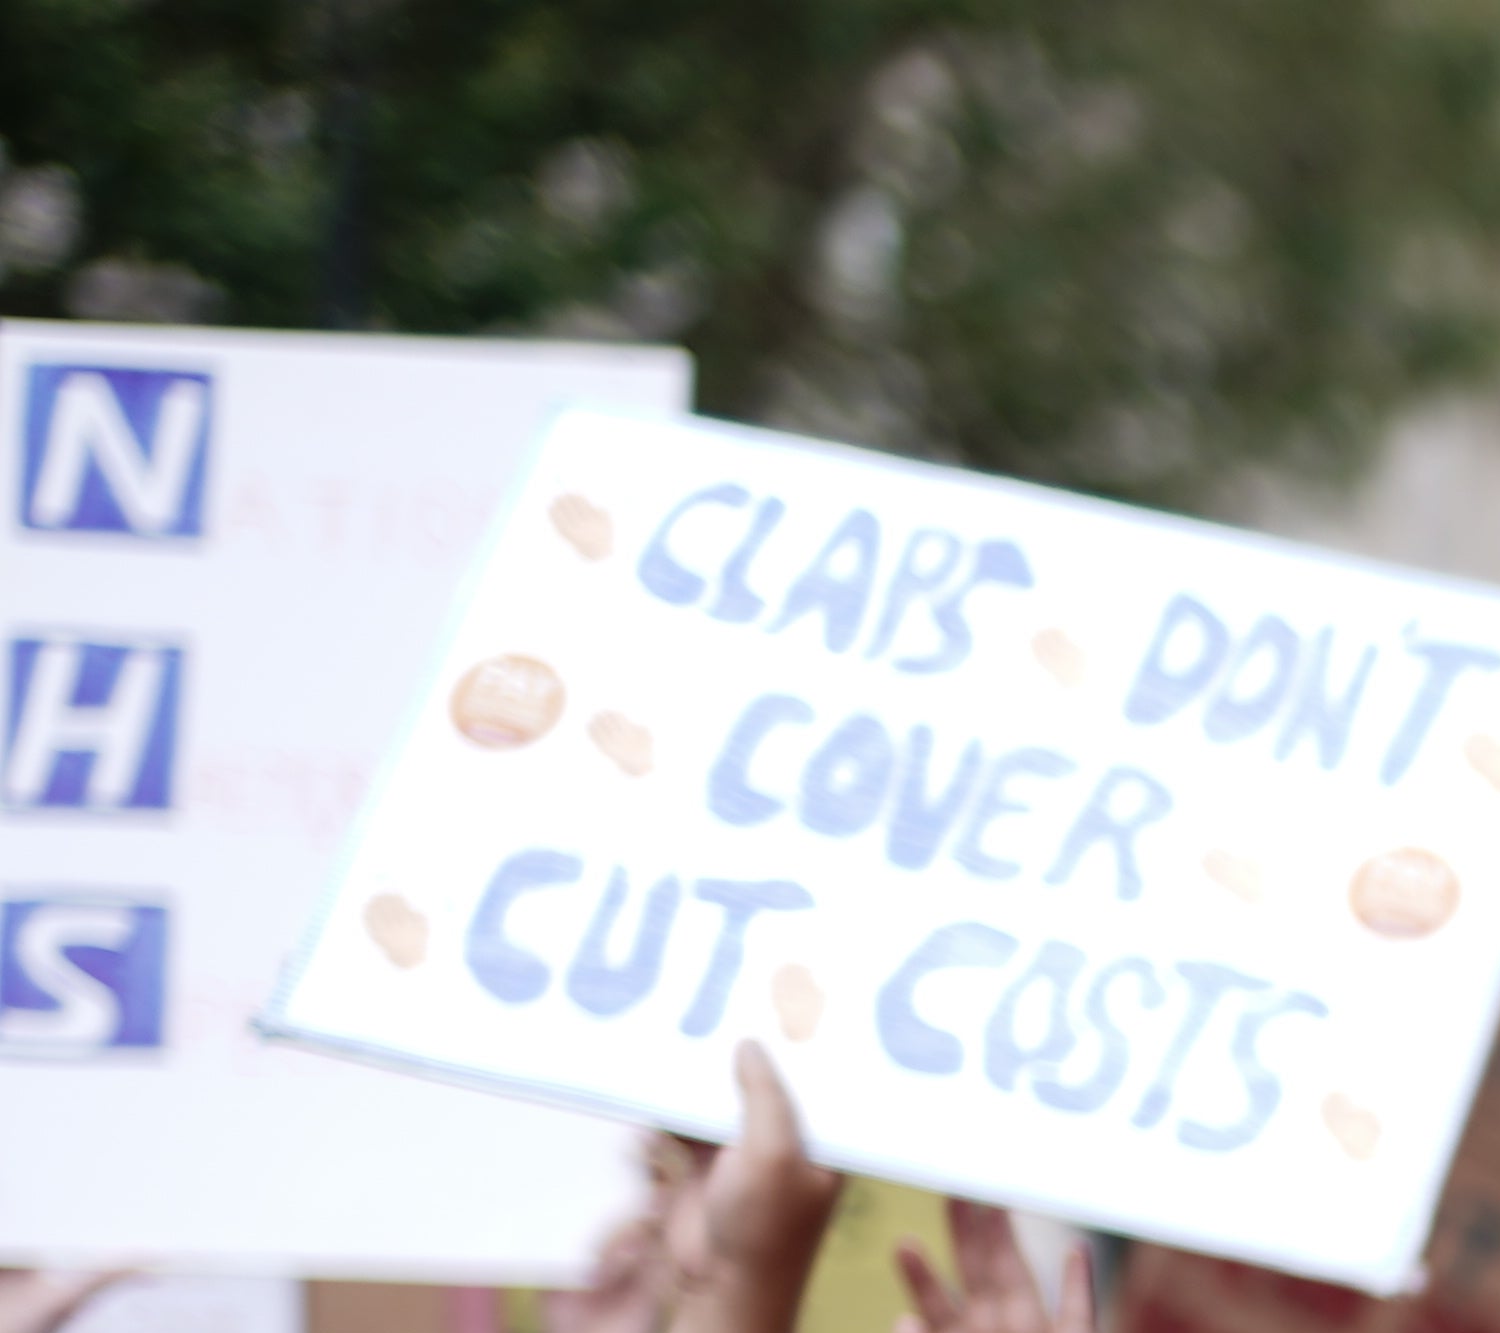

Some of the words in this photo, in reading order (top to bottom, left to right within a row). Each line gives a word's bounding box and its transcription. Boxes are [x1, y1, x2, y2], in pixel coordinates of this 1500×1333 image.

[635, 480, 1036, 676] CLAPS
[703, 690, 1175, 903] COVER
[463, 846, 818, 1041] CUT
[873, 919, 1332, 1155] COSTS
